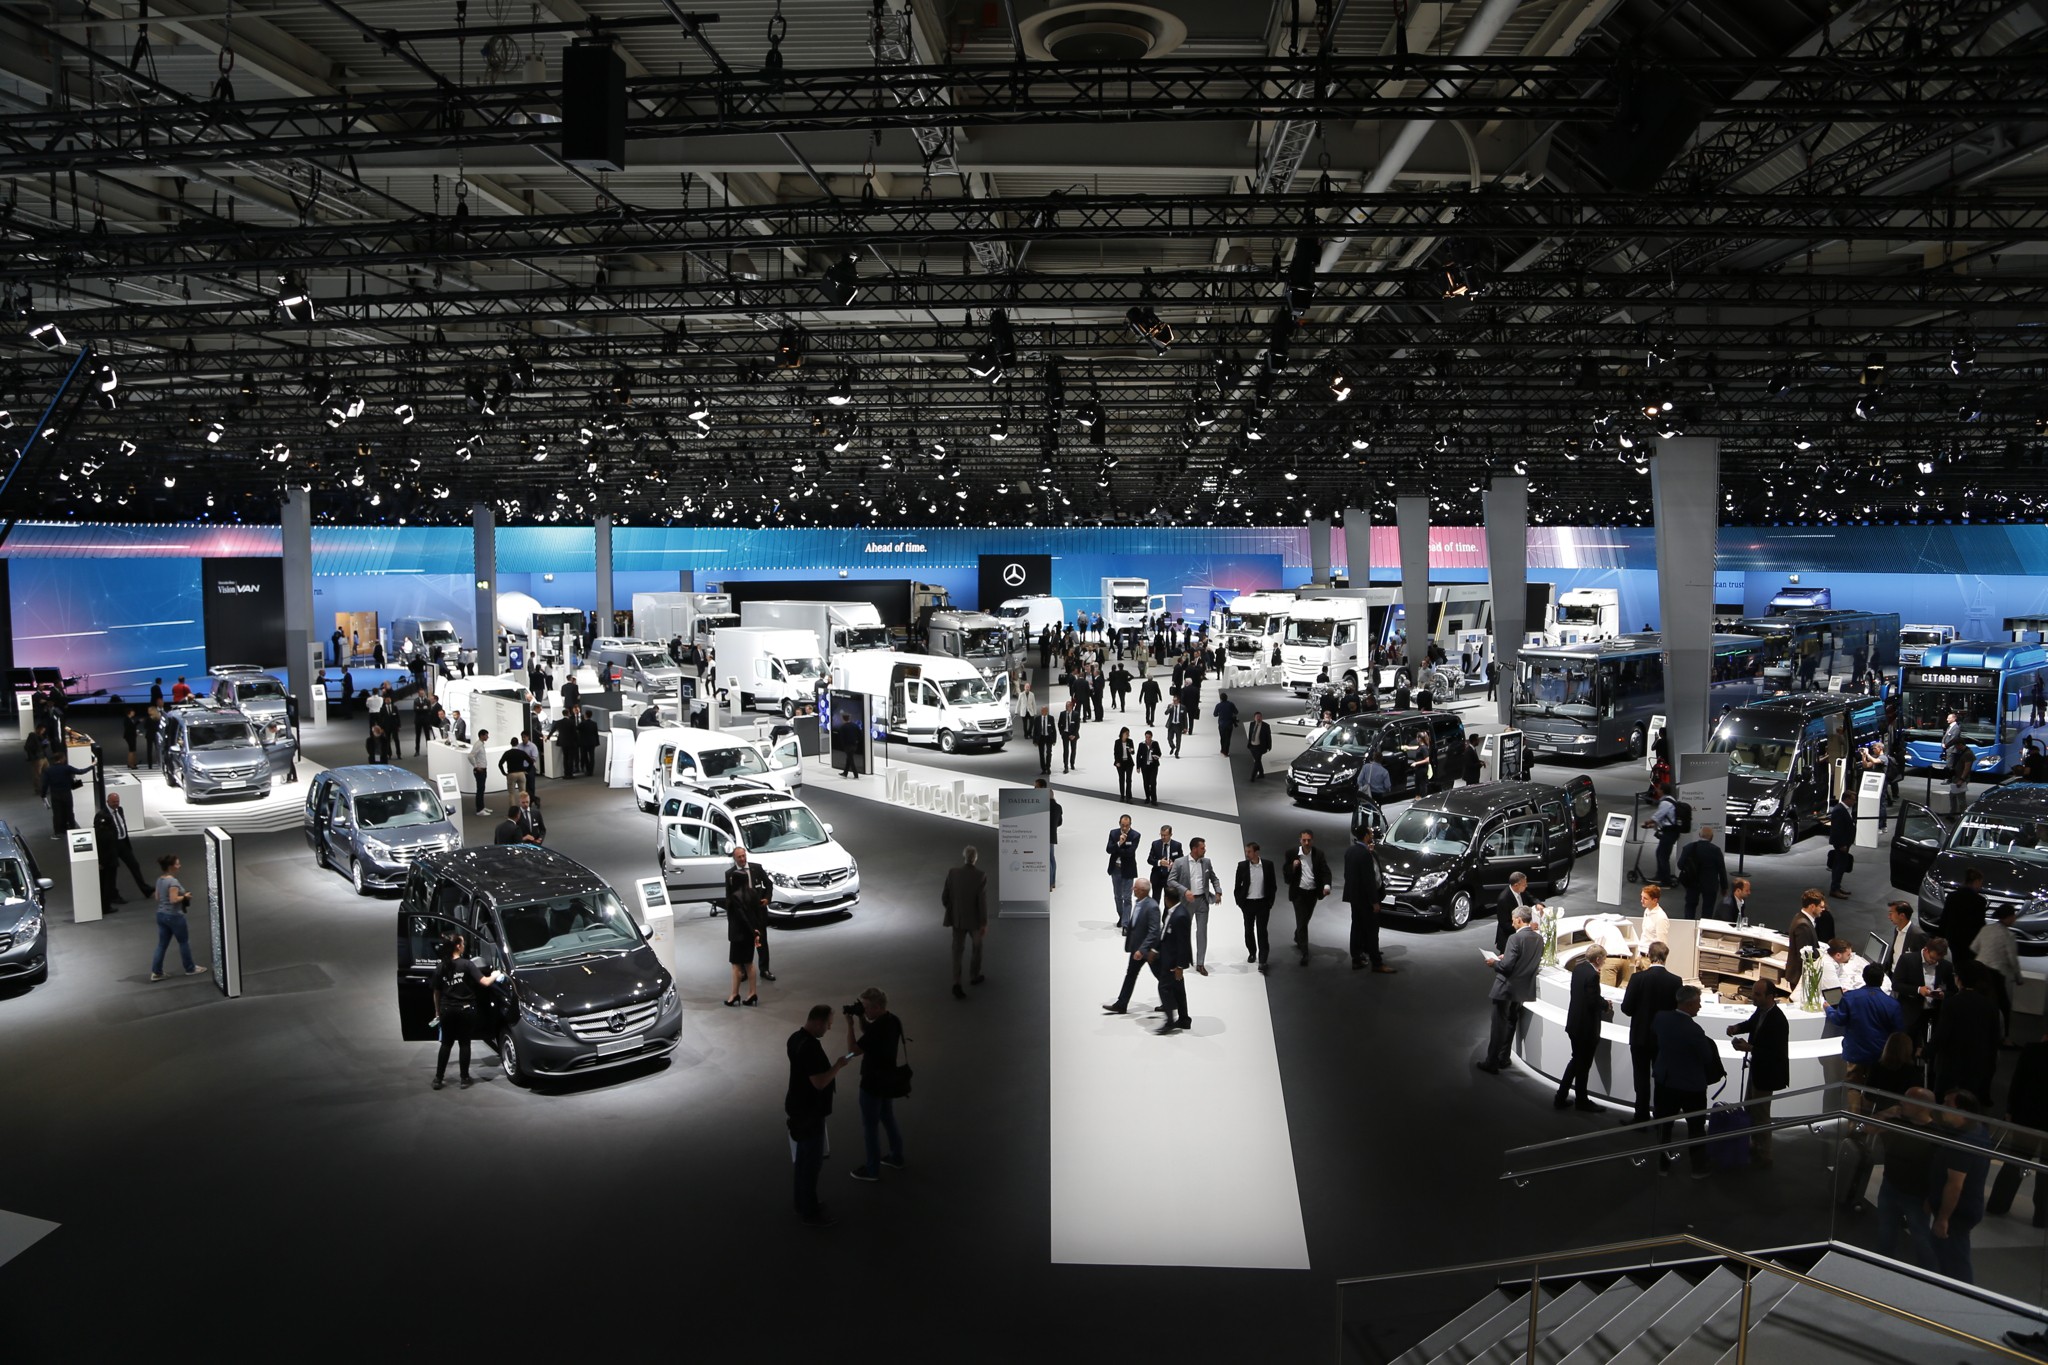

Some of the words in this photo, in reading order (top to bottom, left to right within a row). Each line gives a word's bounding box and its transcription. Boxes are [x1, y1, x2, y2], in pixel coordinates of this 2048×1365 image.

[865, 542, 893, 552] Ahead
[894, 542, 905, 552] of
[905, 542, 928, 552] time.
[1445, 542, 1454, 552] of
[1456, 542, 1479, 552] time.
[237, 585, 260, 593] VAN
[1922, 674, 1957, 683] CITARO
